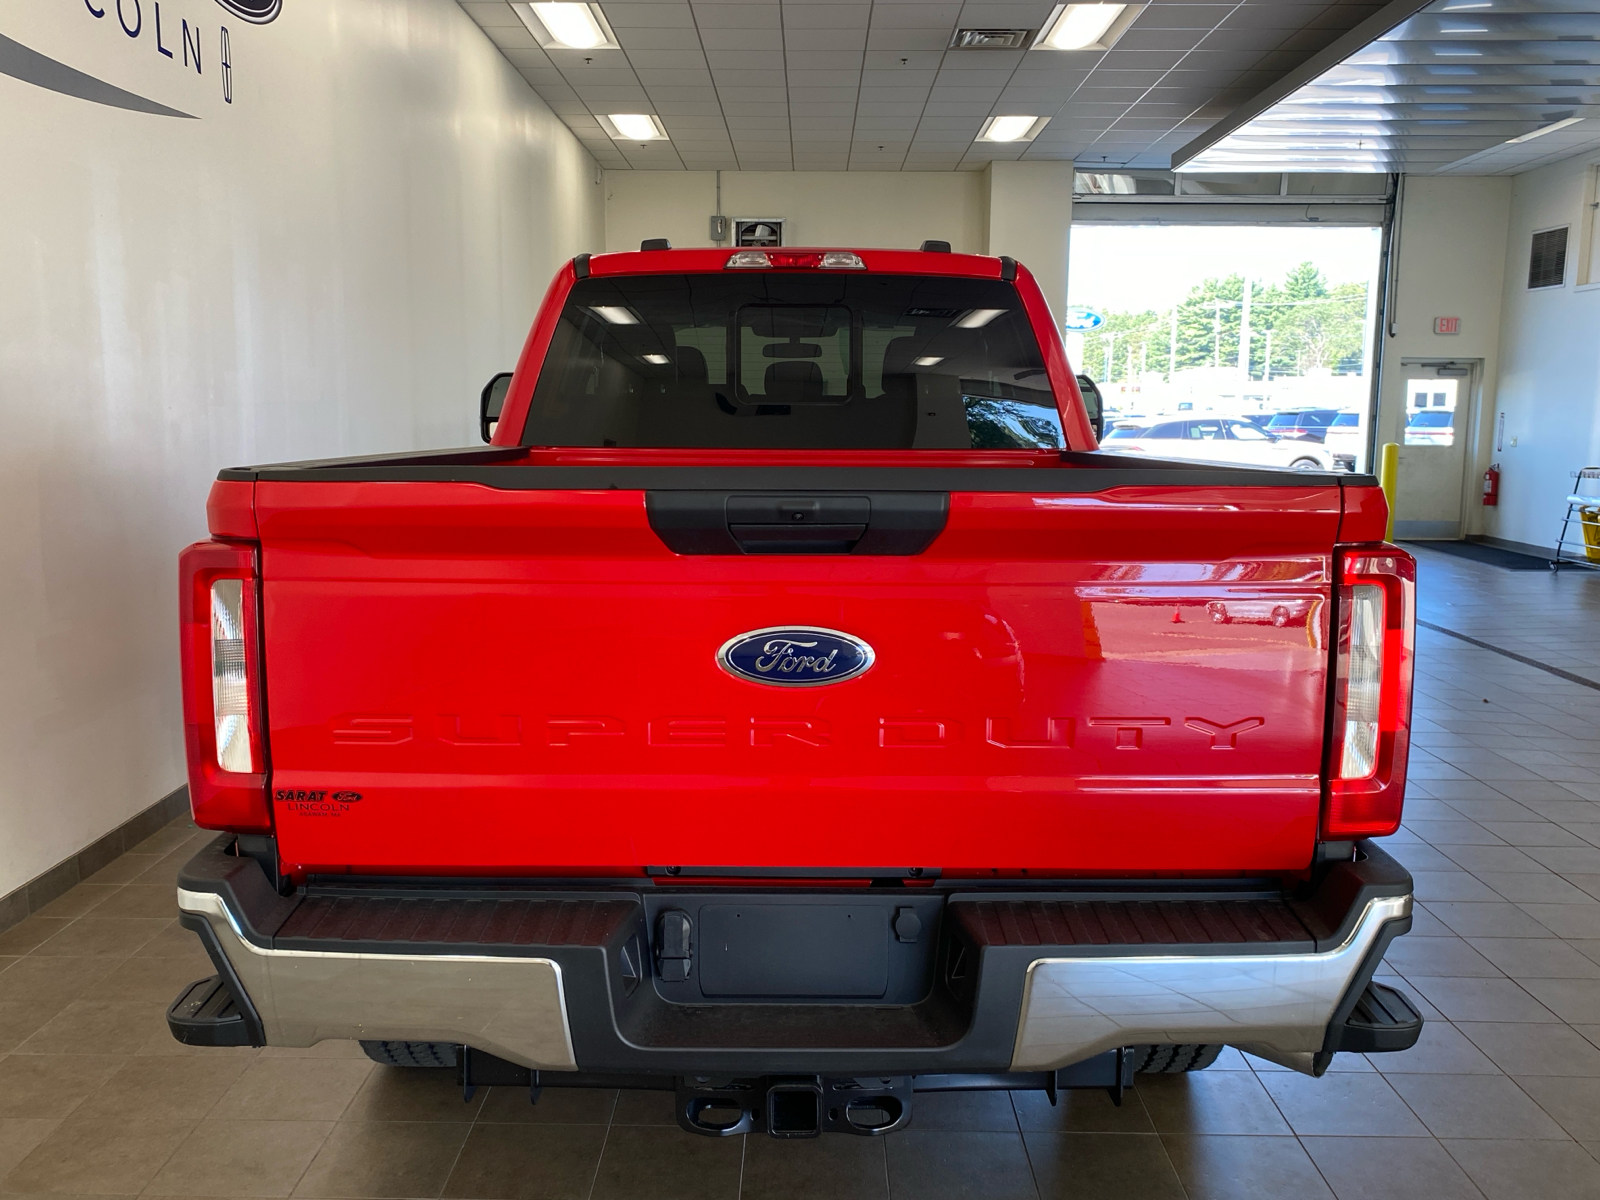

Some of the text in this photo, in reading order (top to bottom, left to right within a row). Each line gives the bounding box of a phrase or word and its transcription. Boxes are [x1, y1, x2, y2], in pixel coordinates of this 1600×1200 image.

[1439, 317, 1459, 332] EXIT
[755, 639, 838, 673] Ford
[333, 713, 1265, 750] SUPER DUTY
[275, 789, 327, 802] SARAT
[287, 803, 350, 812] LINCOLN
